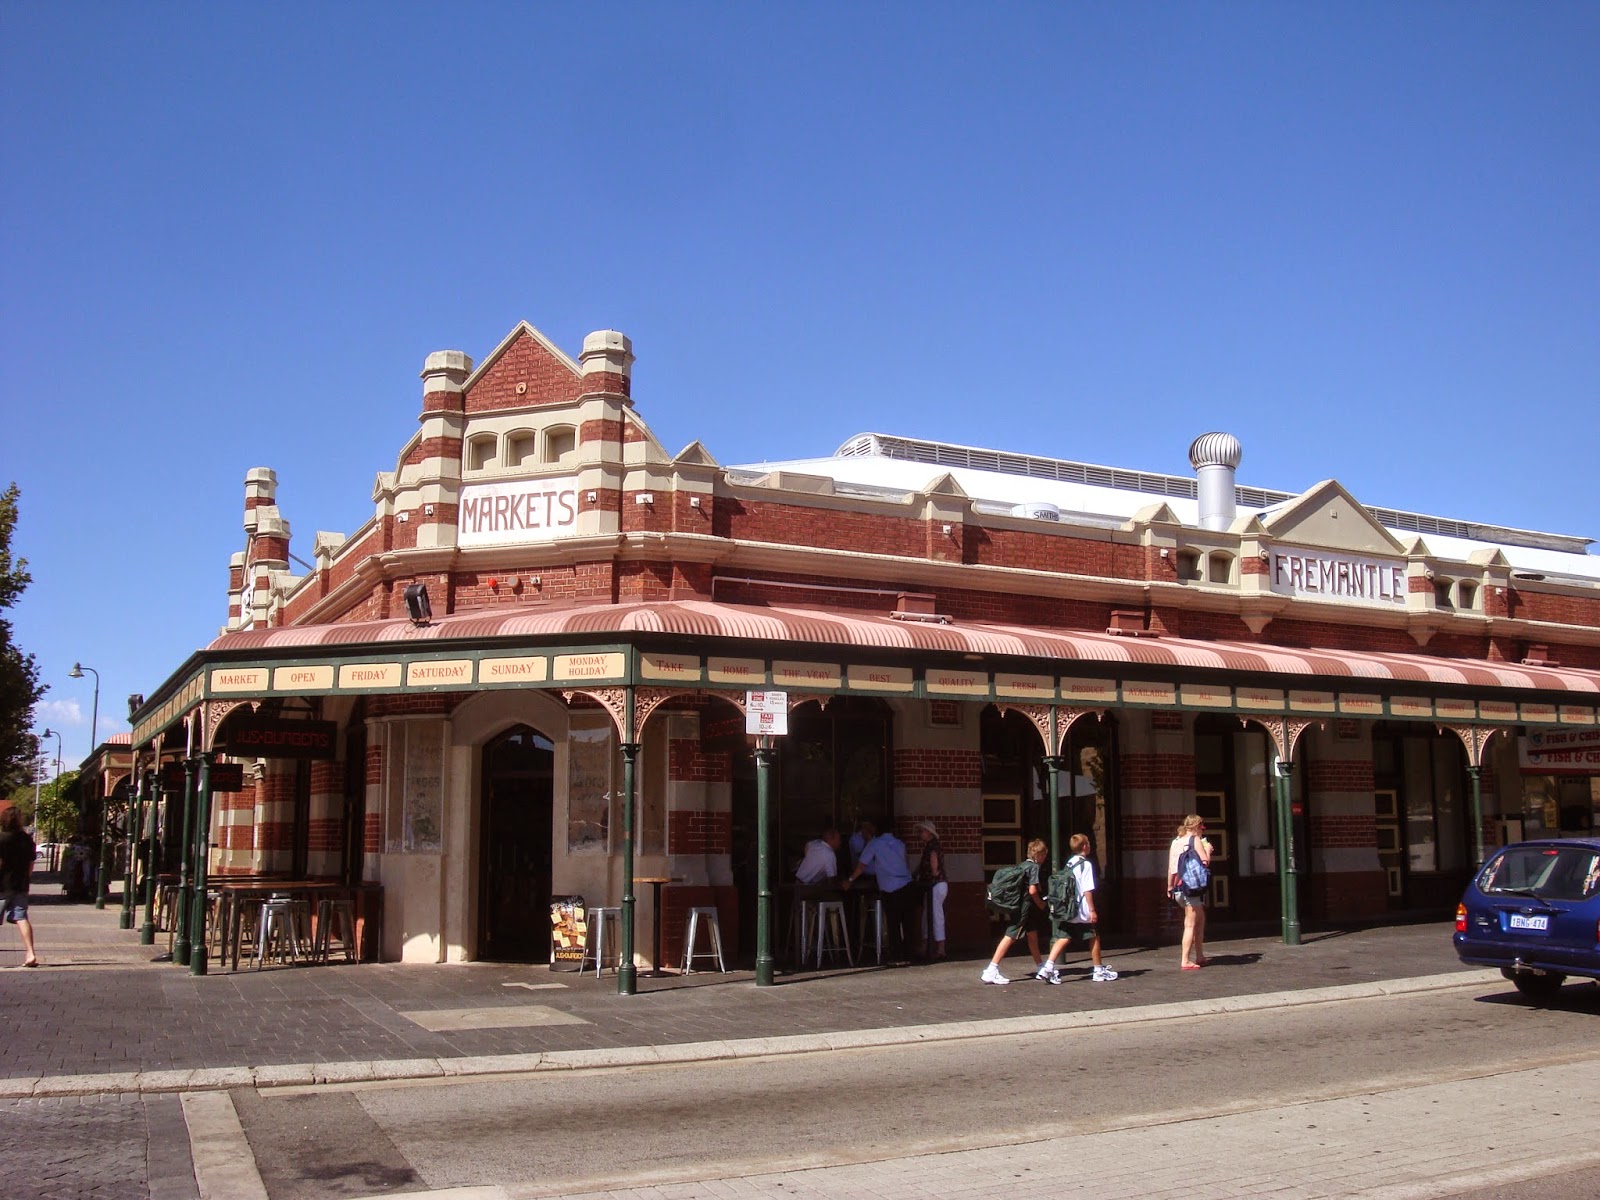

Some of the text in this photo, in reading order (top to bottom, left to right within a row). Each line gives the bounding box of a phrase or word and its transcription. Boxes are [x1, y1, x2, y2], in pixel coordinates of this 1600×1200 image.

[462, 490, 575, 533] MARKETS
[1275, 555, 1404, 601] FREMANTLE
[569, 655, 607, 666] MONDAY
[412, 665, 467, 678] SATURDAY
[491, 662, 535, 675] SUNDAY
[568, 665, 608, 676] HOLIDAY
[723, 666, 749, 675] HOME
[290, 672, 316, 682] OPEN
[351, 668, 388, 681] FRIDAY
[782, 669, 832, 680] THE VERY
[869, 673, 892, 683] BEST
[219, 675, 258, 685] MARKET
[938, 677, 975, 687] QUALITY
[1012, 681, 1037, 691] FRESH
[1071, 684, 1105, 694] PRODUCE
[1128, 687, 1169, 698] AVAILABLE
[1199, 692, 1213, 700] ALL
[1251, 694, 1269, 703] YEAR
[1345, 699, 1373, 708] MARKET
[1402, 702, 1419, 710] OPEN
[1546, 734, 1567, 744] FISH
[1569, 733, 1576, 742] &
[1547, 752, 1571, 762] FISH
[1575, 752, 1583, 762] &
